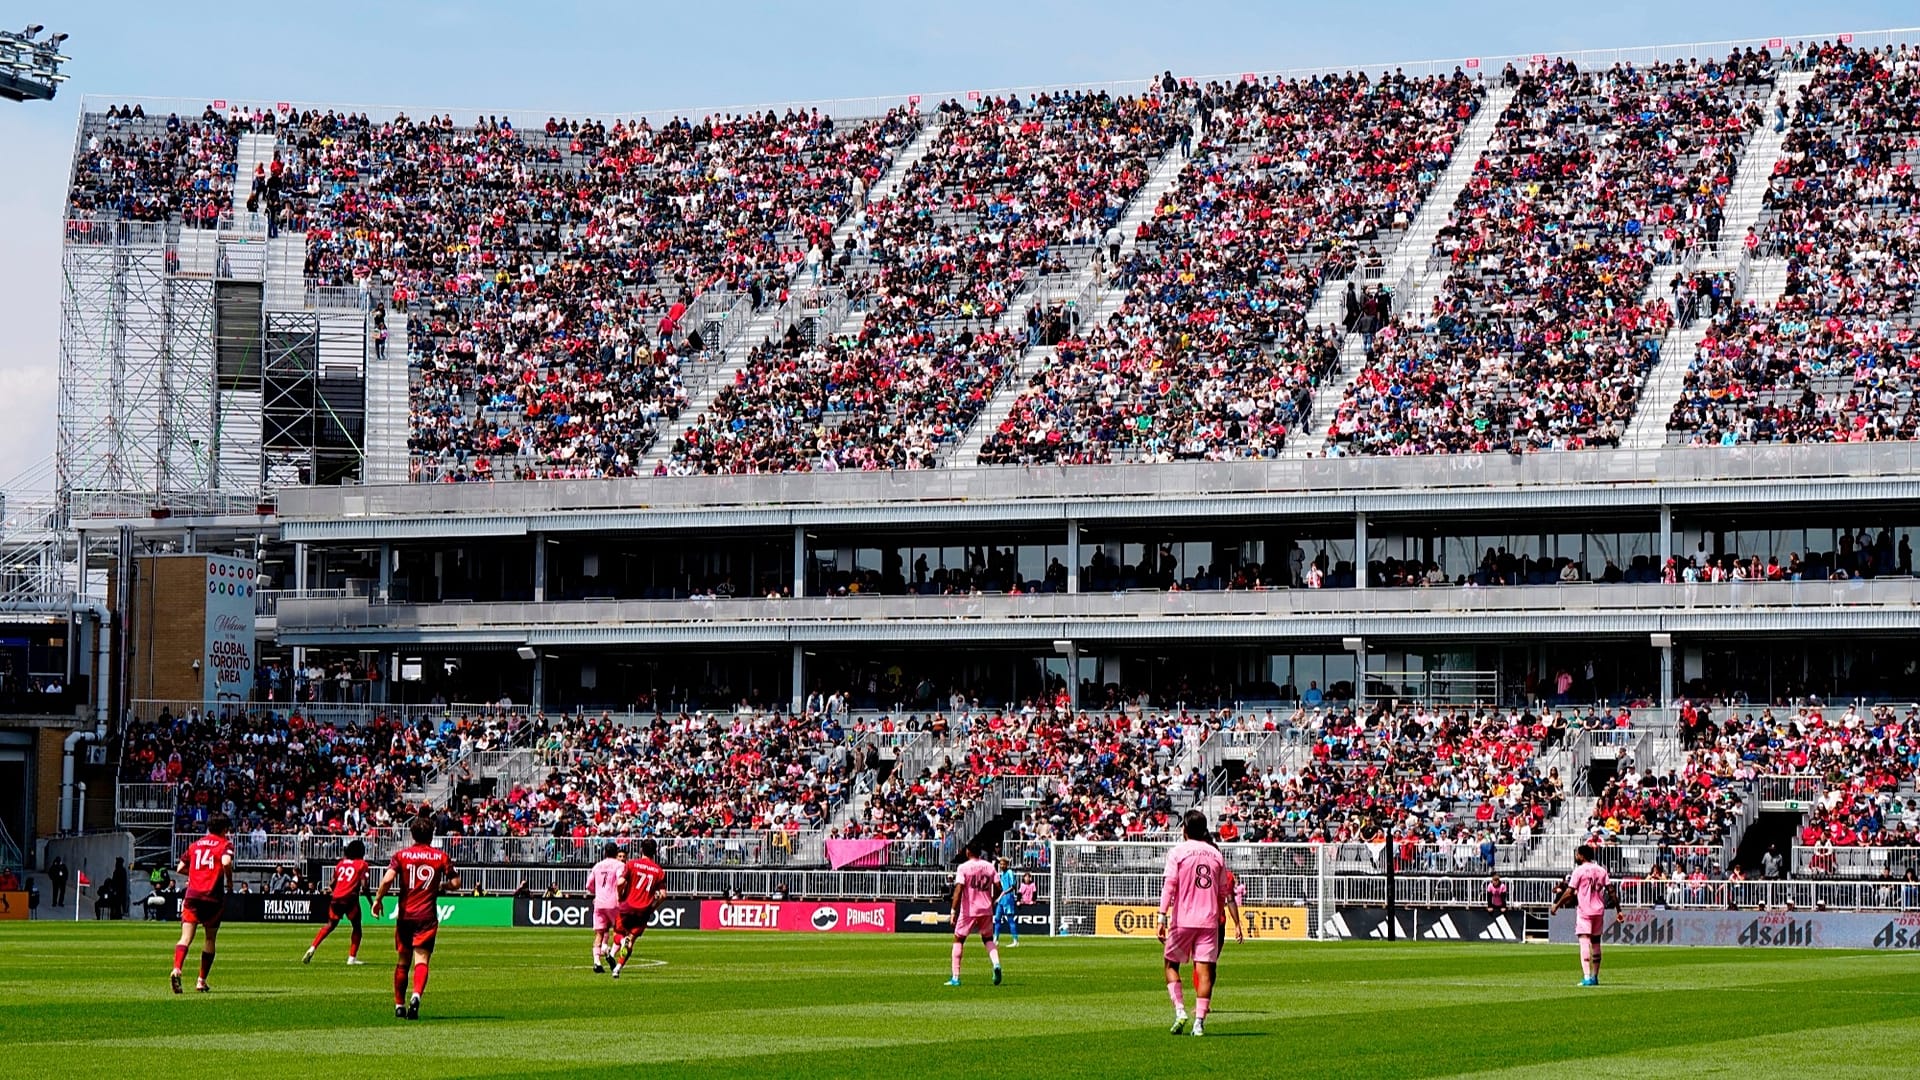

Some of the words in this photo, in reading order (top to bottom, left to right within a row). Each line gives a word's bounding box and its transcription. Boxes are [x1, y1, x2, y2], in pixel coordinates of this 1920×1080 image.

[213, 640, 247, 656] GLOBAL
[209, 654, 250, 671] TORONTO
[219, 669, 241, 684] AREA
[194, 850, 214, 870] 14
[402, 852, 442, 861] FRANKLIN
[337, 867, 355, 882] 29
[406, 864, 435, 890] 19
[600, 872, 608, 888] 7
[969, 875, 991, 891] 42
[1195, 864, 1212, 889] 8
[528, 900, 589, 925] Uber
[846, 907, 885, 927] PRINGLES
[1602, 916, 1673, 944] Asahi
[1737, 919, 1812, 946] Asahi
